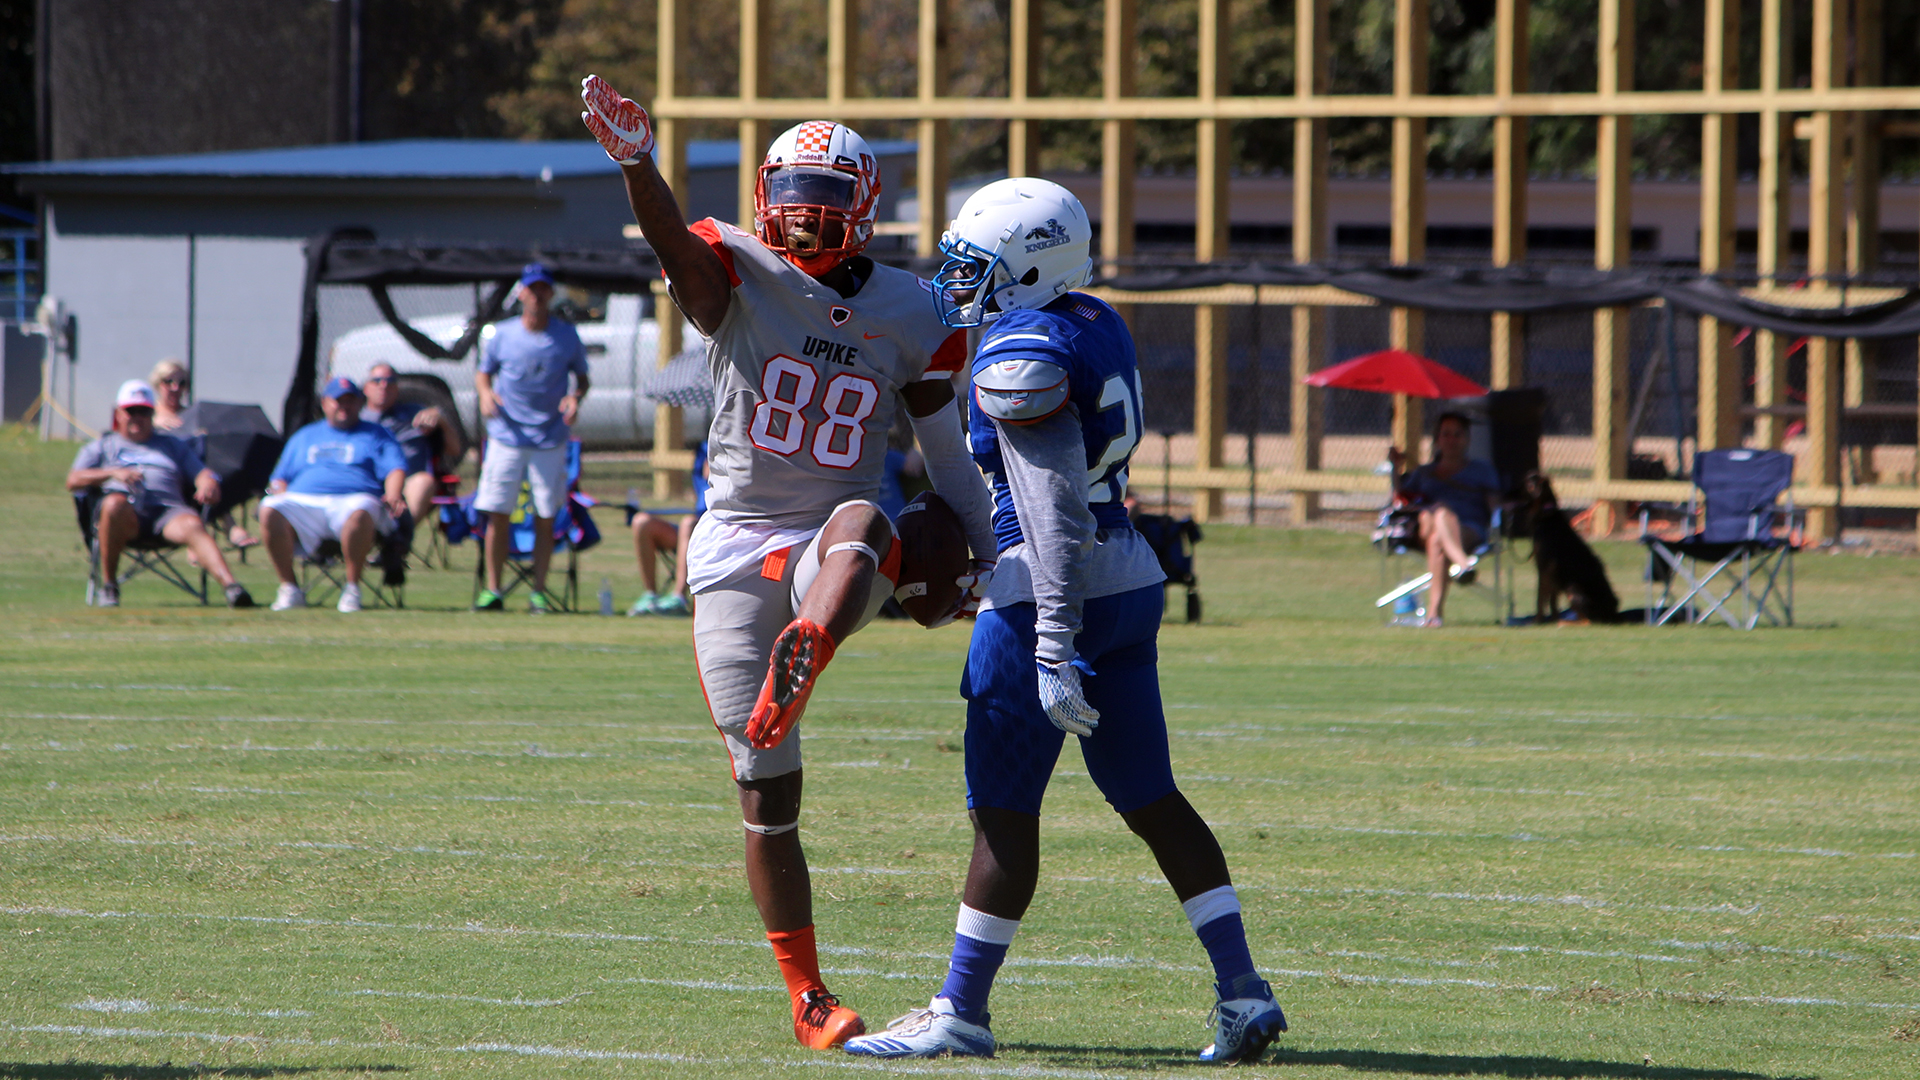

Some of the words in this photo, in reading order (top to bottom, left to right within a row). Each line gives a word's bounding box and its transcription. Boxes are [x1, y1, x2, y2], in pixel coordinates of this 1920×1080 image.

[1025, 235, 1071, 254] KNIGHTS
[802, 335, 858, 367] UPIKE
[747, 353, 880, 470] 88
[1227, 1012, 1249, 1048] adidas
